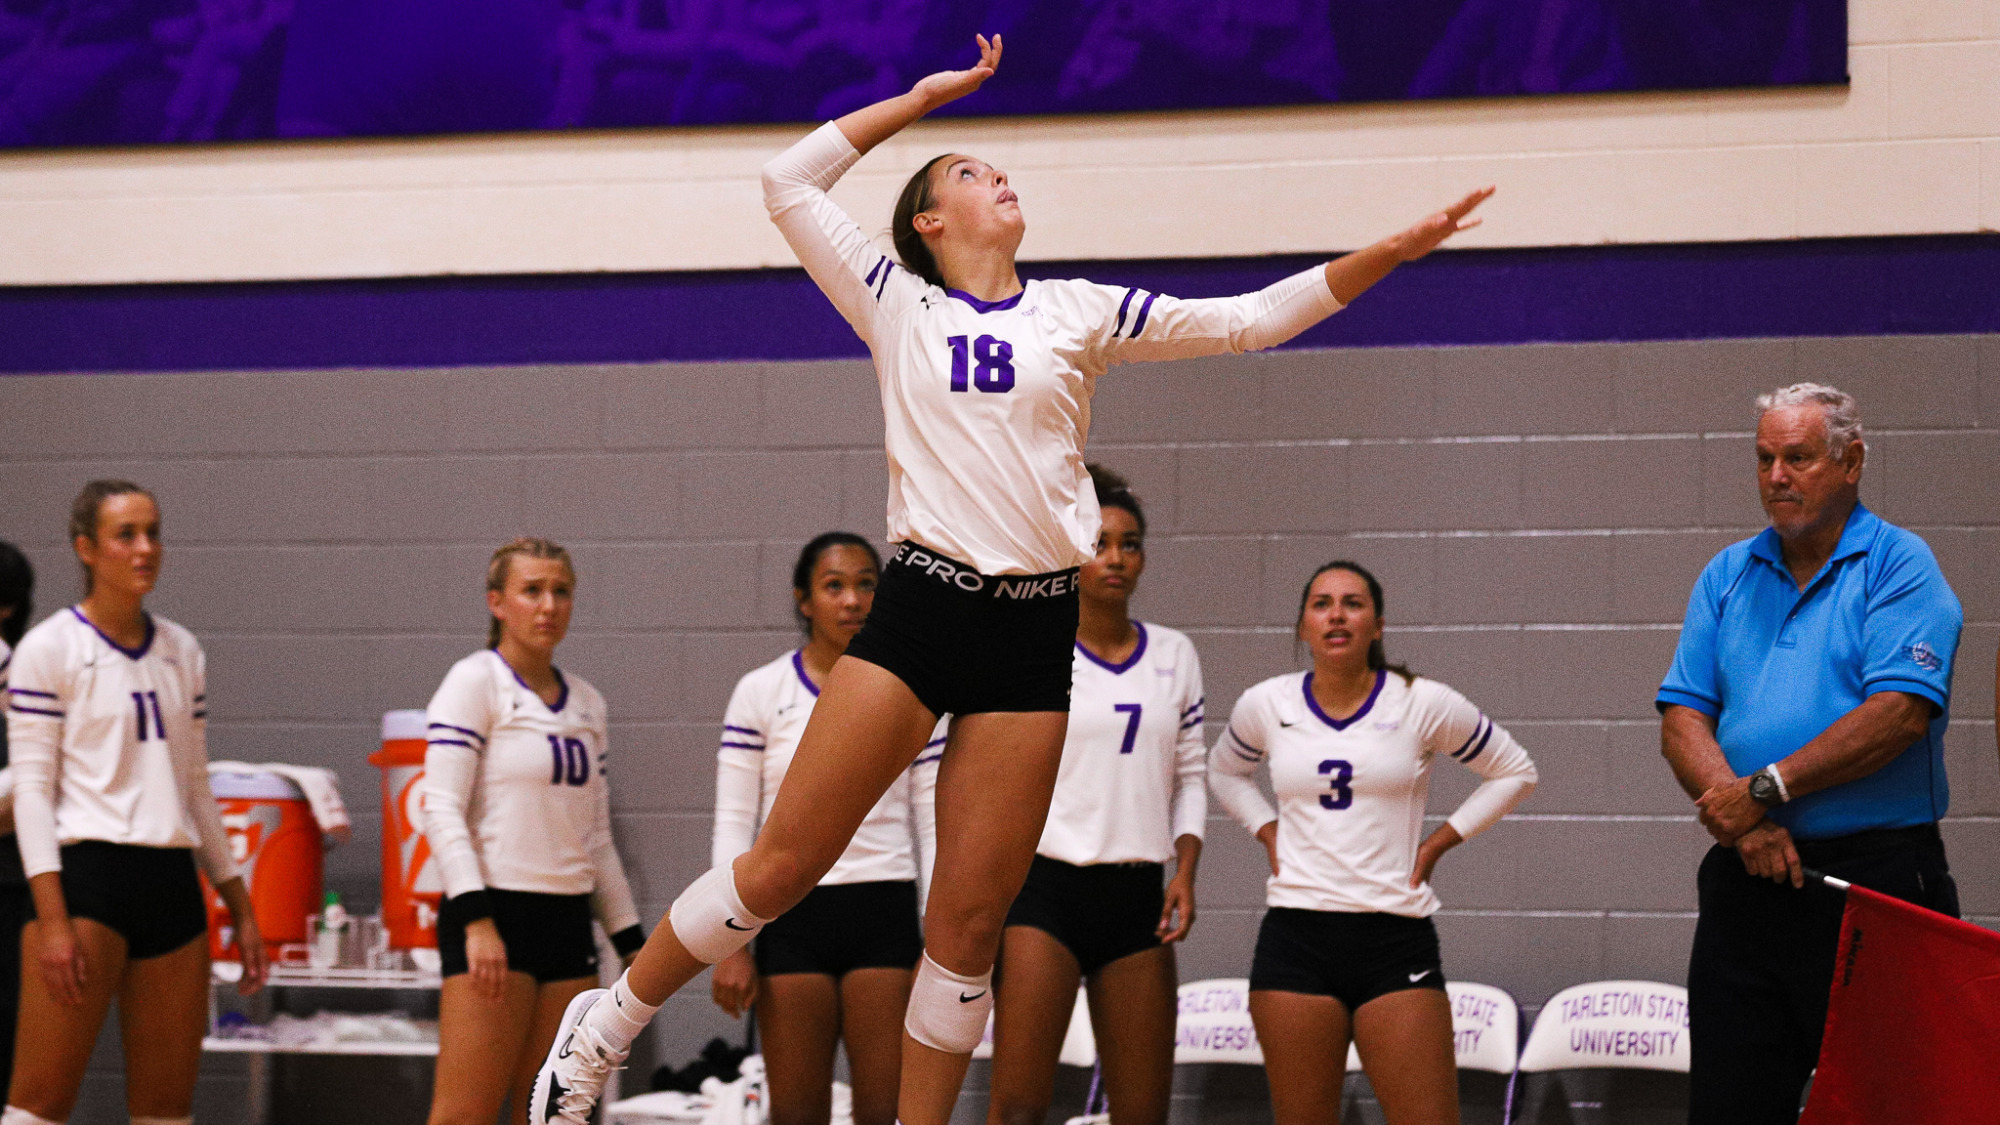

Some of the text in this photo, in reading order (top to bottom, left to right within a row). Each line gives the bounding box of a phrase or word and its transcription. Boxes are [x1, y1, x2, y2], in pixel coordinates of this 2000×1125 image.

[946, 334, 1015, 393] 18
[905, 550, 984, 592] PRO
[994, 575, 1067, 600] NIKE
[131, 691, 165, 741] 11
[1114, 703, 1142, 755] 7
[547, 733, 589, 786] 10
[1318, 759, 1353, 810] 3
[1457, 994, 1498, 1028] STATE
[1562, 992, 1643, 1024] TARLETON
[1571, 1028, 1680, 1057] UNIVERSITY
